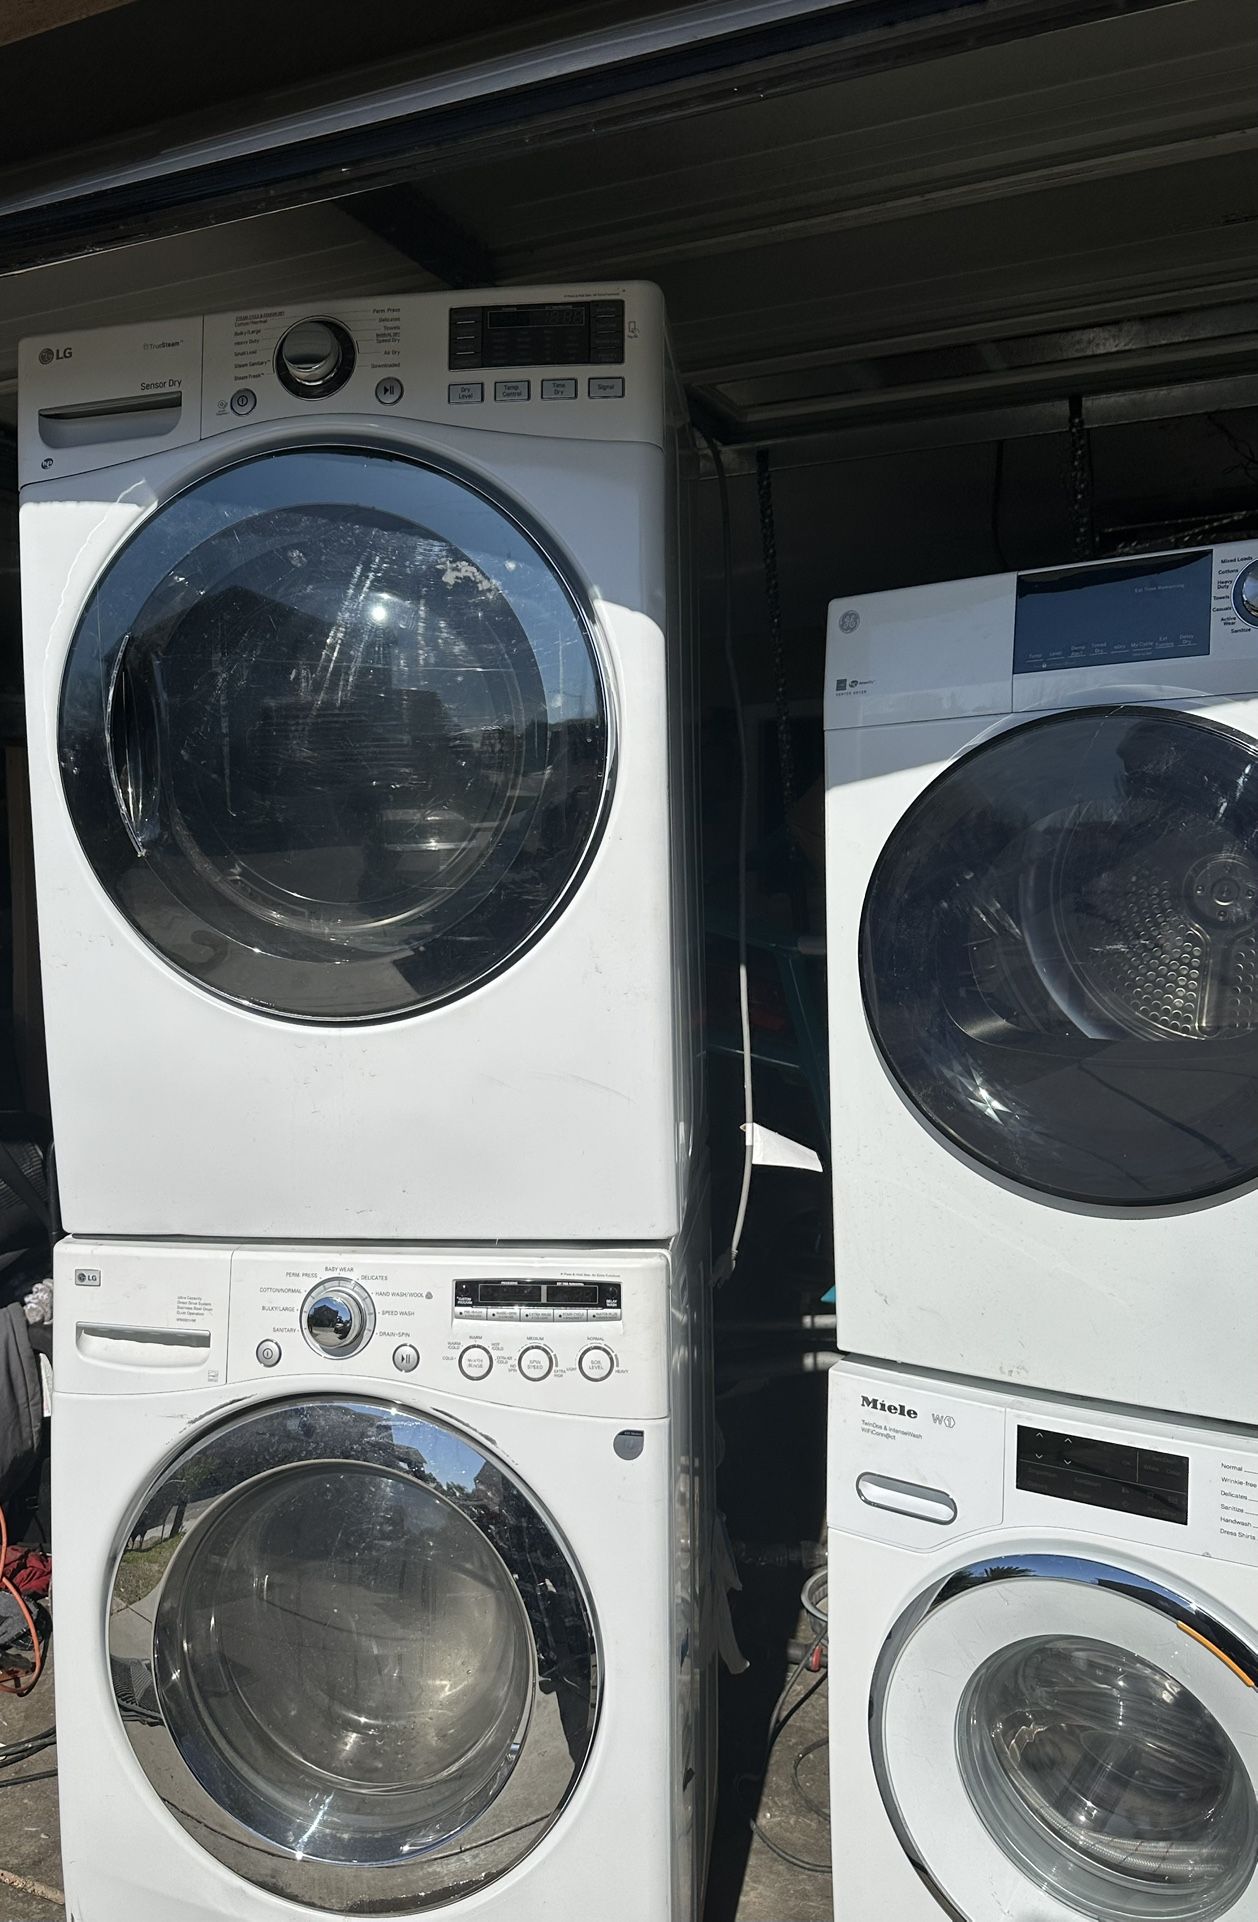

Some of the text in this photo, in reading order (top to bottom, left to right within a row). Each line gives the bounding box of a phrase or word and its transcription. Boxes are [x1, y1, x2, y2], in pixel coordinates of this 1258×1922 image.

[55, 347, 73, 360] LG
[140, 378, 183, 391] Sensor Dry
[597, 383, 615, 391] Signal
[458, 391, 473, 399] Level
[461, 386, 471, 394] Dry
[502, 390, 522, 398] Control
[860, 1395, 918, 1419] Miele
[861, 1420, 883, 1430] TwinDos
[888, 1426, 922, 1440] IntenseWash
[1221, 1462, 1243, 1472] Normal
[1220, 1490, 1248, 1500] Delicates
[1220, 1504, 1244, 1513] Sanitize
[1220, 1516, 1252, 1527] Handwash
[1220, 1528, 1256, 1540] Dress Shirts
